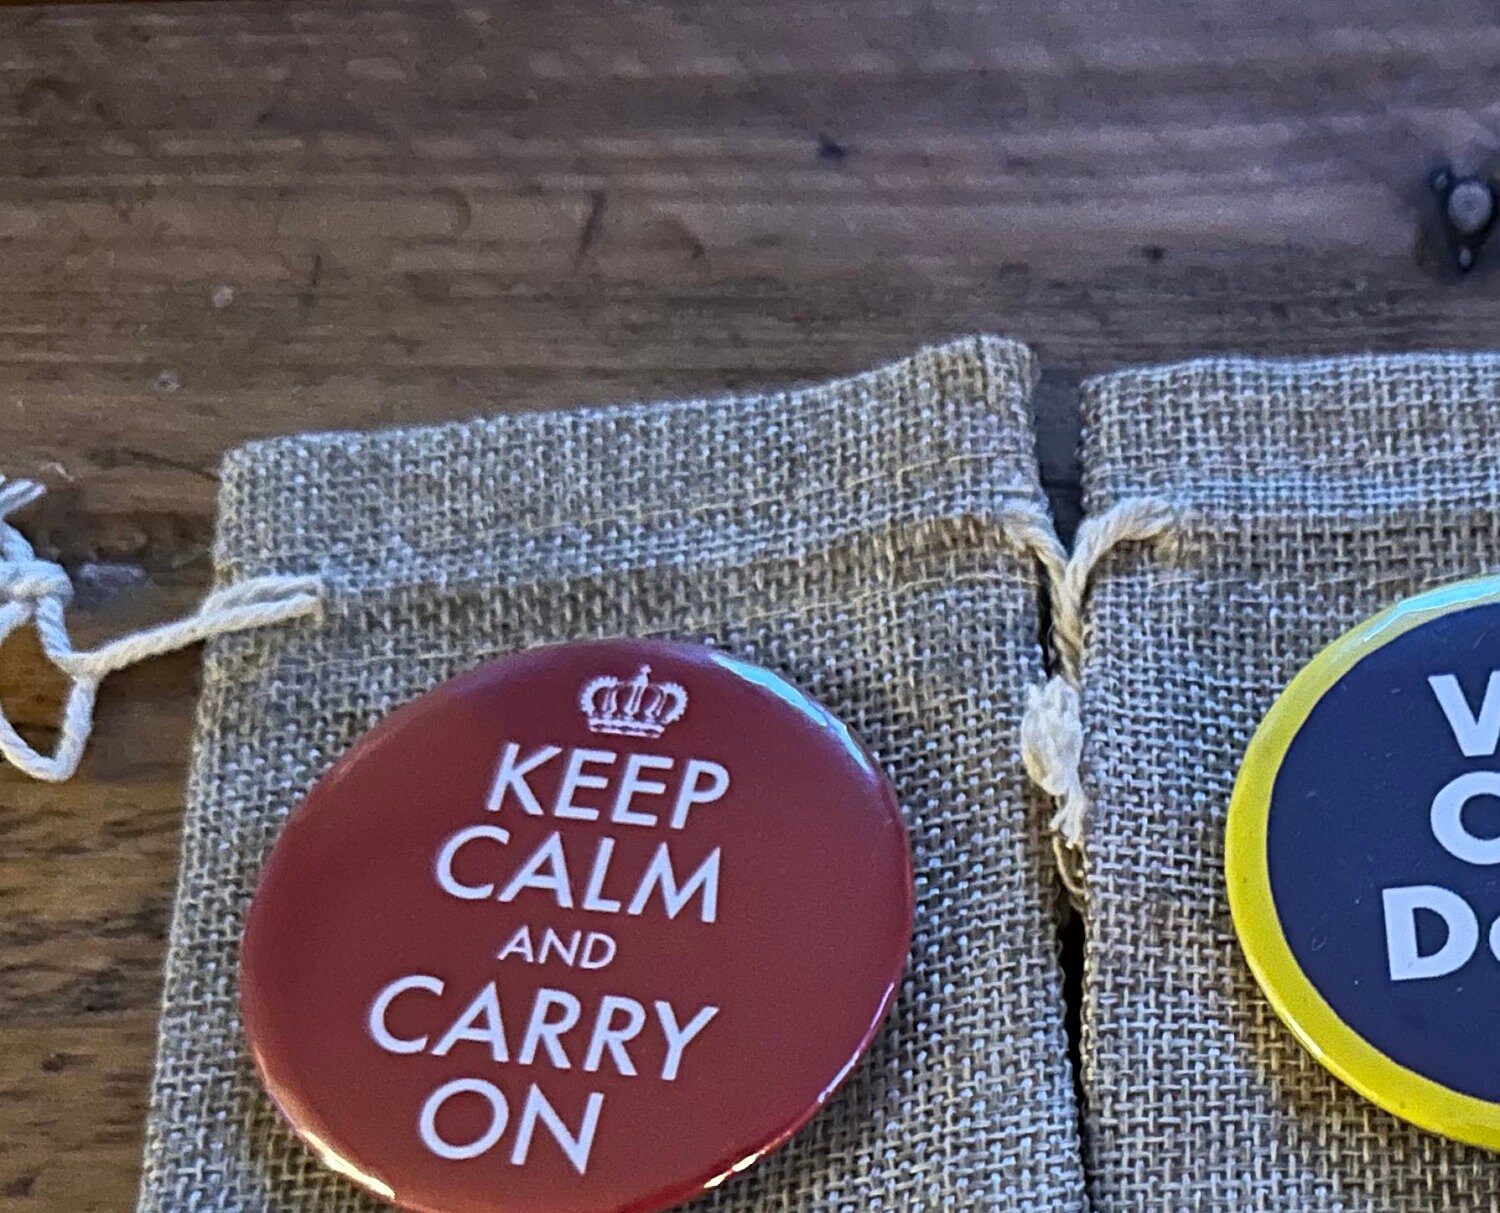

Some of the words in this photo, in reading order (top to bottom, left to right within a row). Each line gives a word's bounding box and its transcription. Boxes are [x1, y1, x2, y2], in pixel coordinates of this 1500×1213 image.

[485, 740, 732, 832] KEEP
[433, 823, 723, 926] CALM
[495, 923, 619, 971] AND
[367, 973, 721, 1084] CARRY
[417, 1076, 607, 1177] ON
